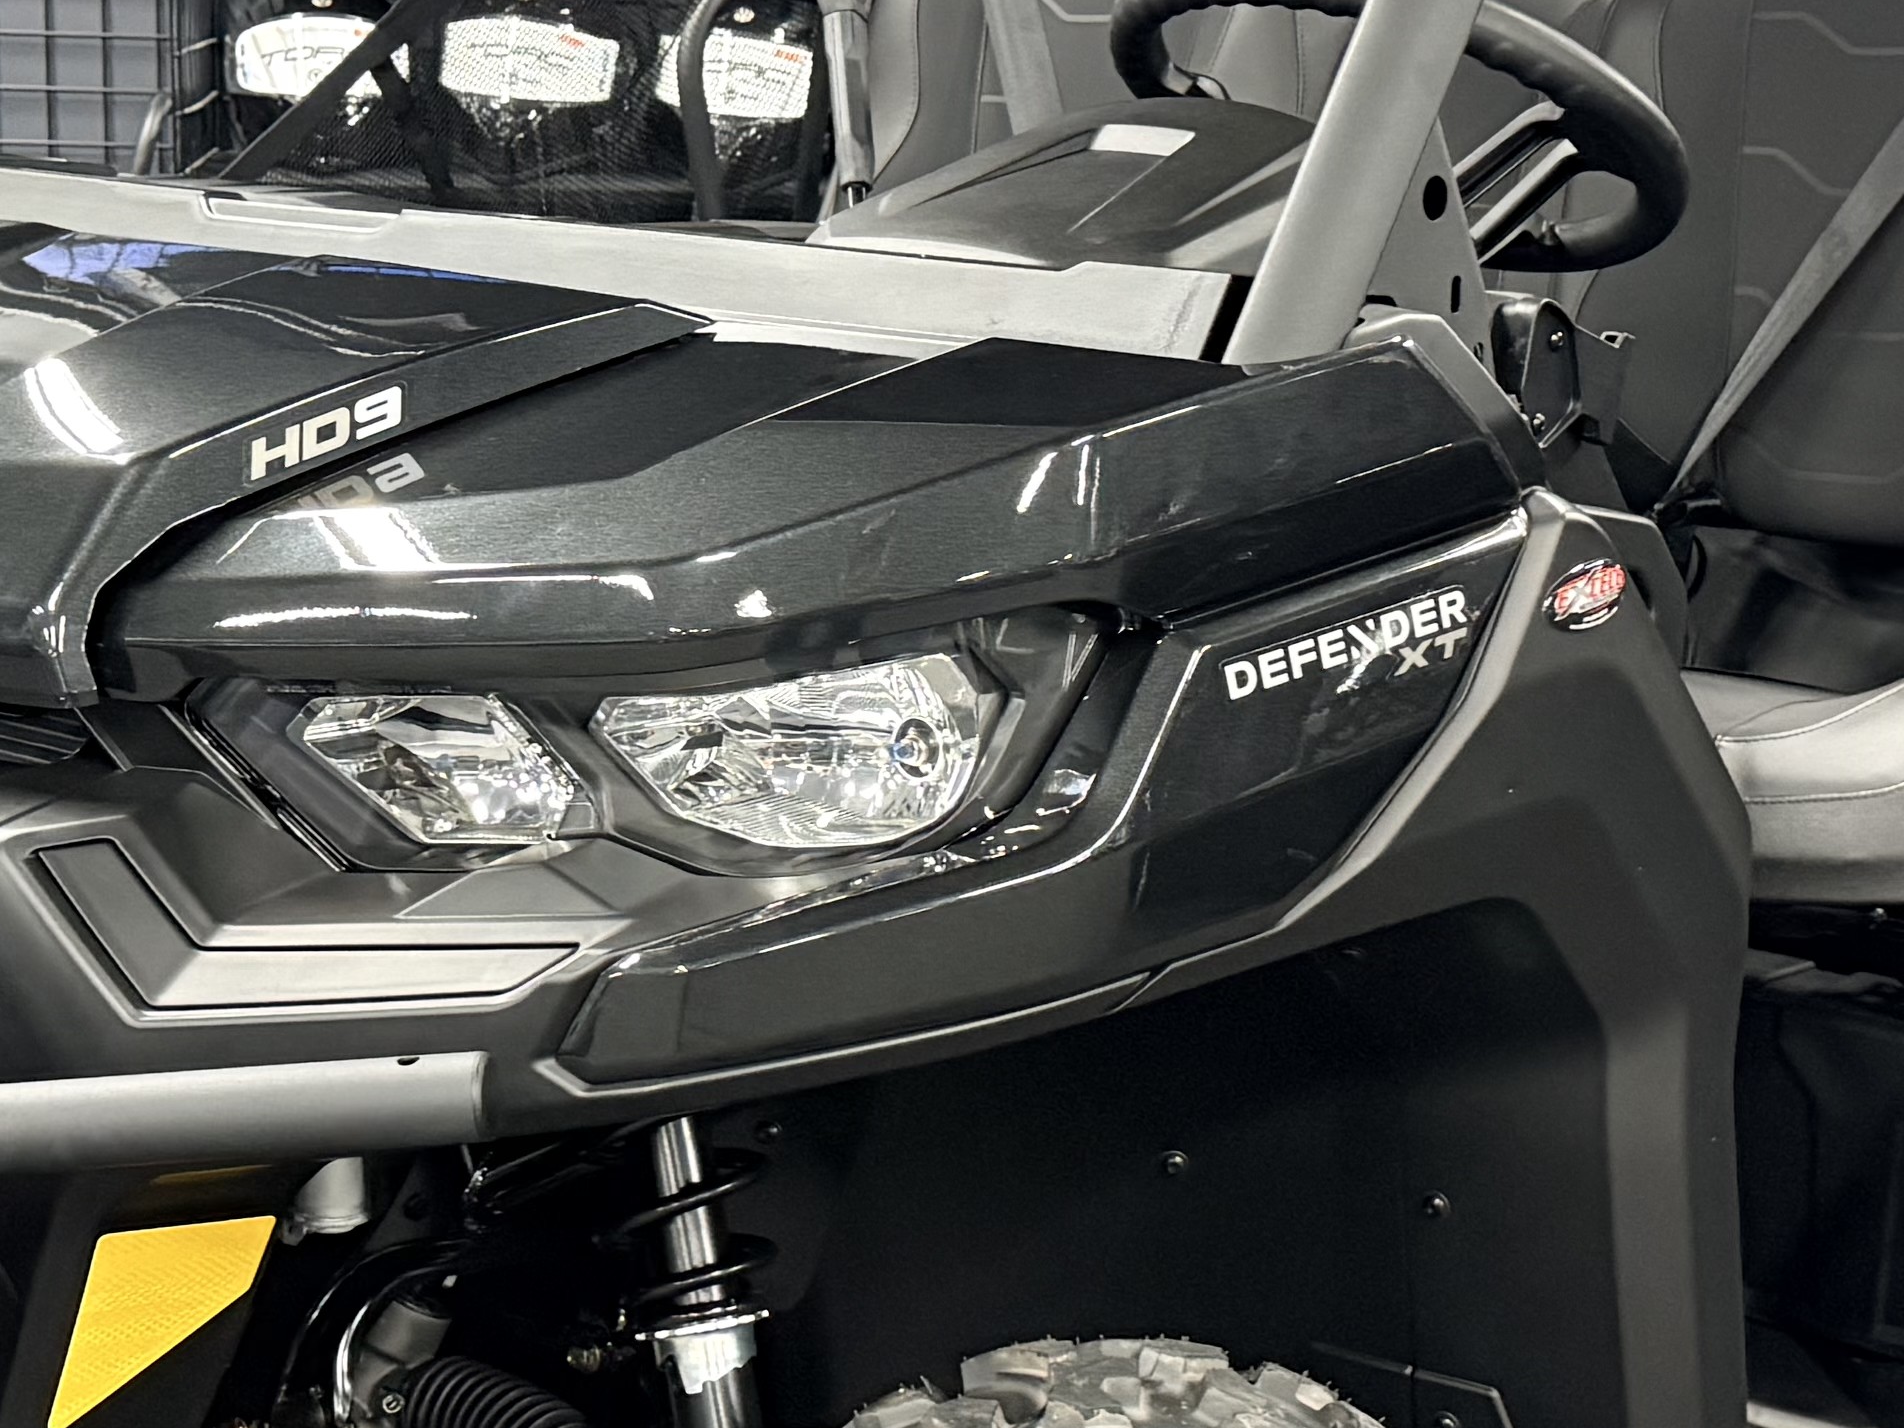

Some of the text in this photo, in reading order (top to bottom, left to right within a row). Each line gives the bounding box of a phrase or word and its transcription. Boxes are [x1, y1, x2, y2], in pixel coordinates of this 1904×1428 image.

[251, 385, 402, 481] HD9
[1223, 590, 1467, 700] DEFENDER
[1394, 627, 1468, 676] XT
